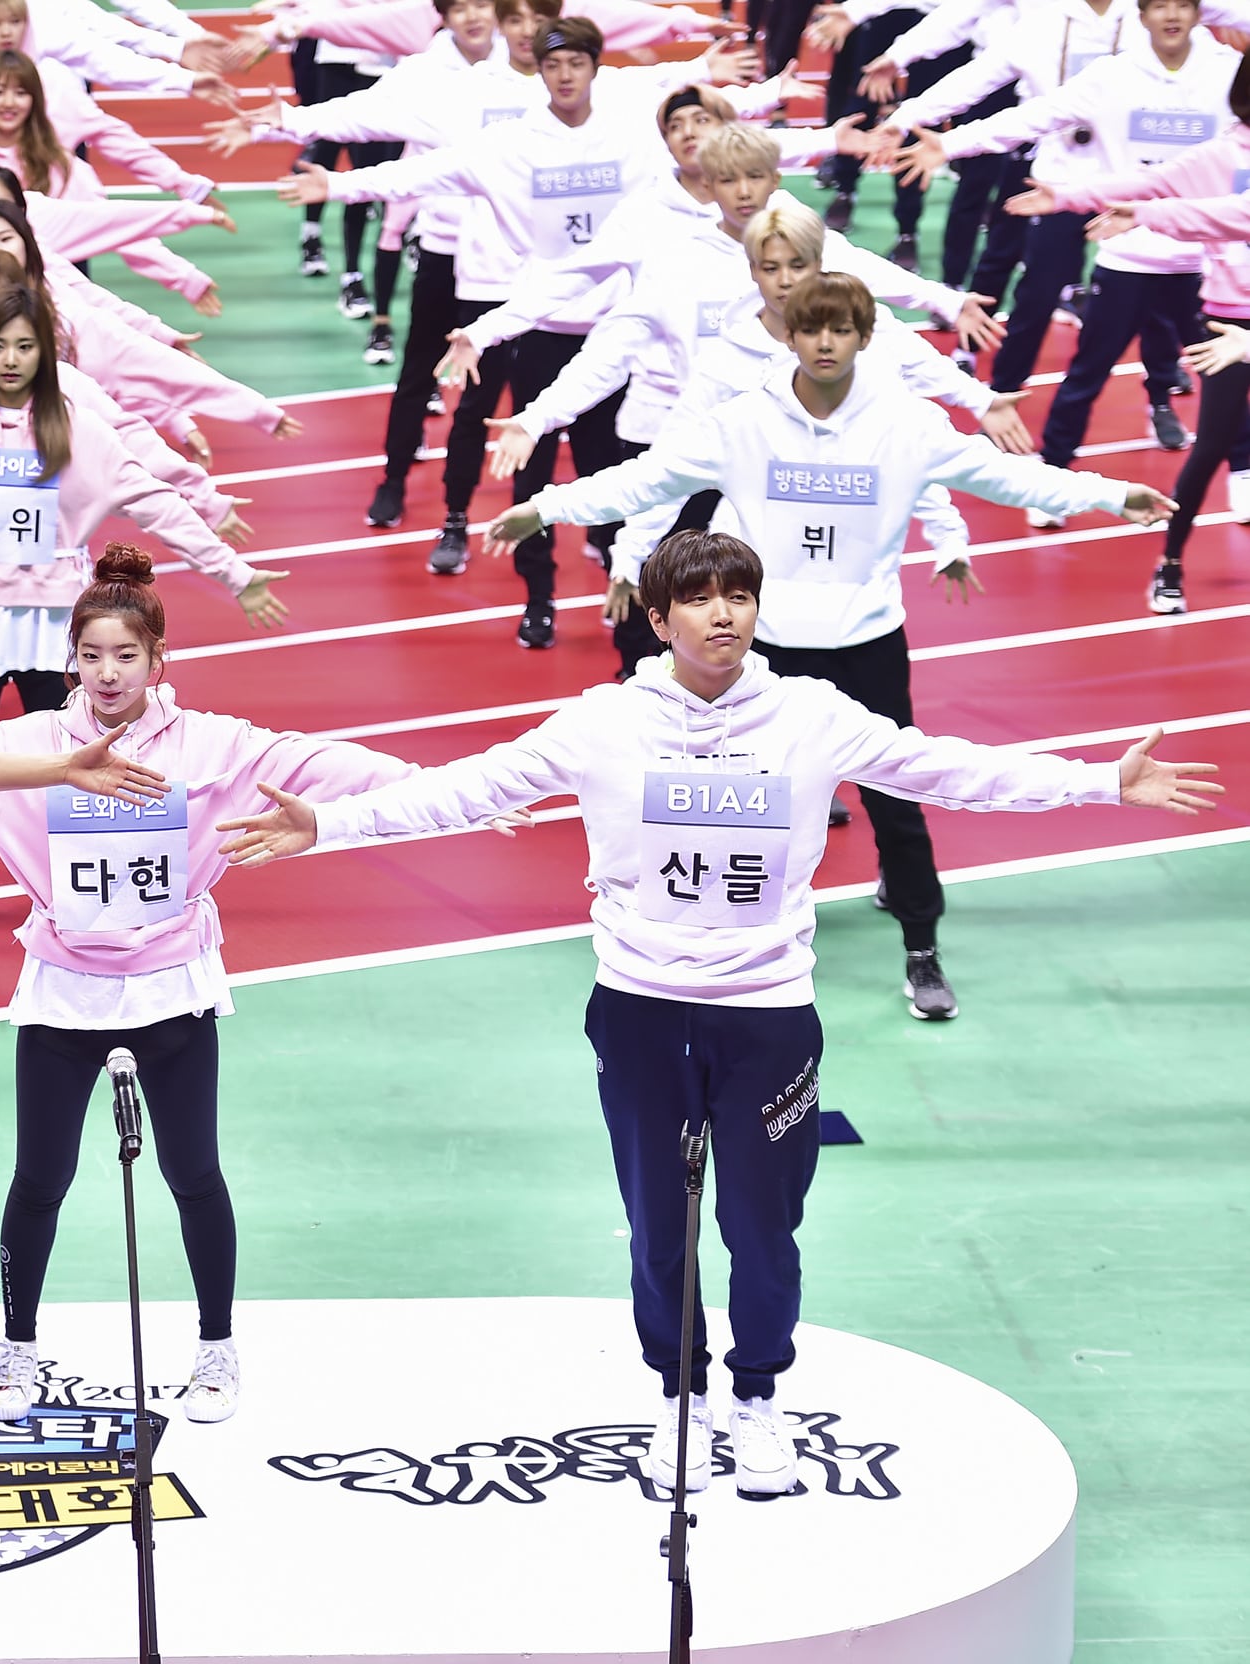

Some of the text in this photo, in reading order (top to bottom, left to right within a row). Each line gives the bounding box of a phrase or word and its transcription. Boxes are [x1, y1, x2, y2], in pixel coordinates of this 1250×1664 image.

[538, 165, 617, 193] 방탄소년단
[565, 213, 592, 244] 진
[774, 468, 874, 498] 방탄소년단
[801, 525, 836, 561] 뷔
[69, 794, 168, 820] 트와이스
[667, 783, 769, 815] B1A4
[82, 1385, 190, 1401] 2017
